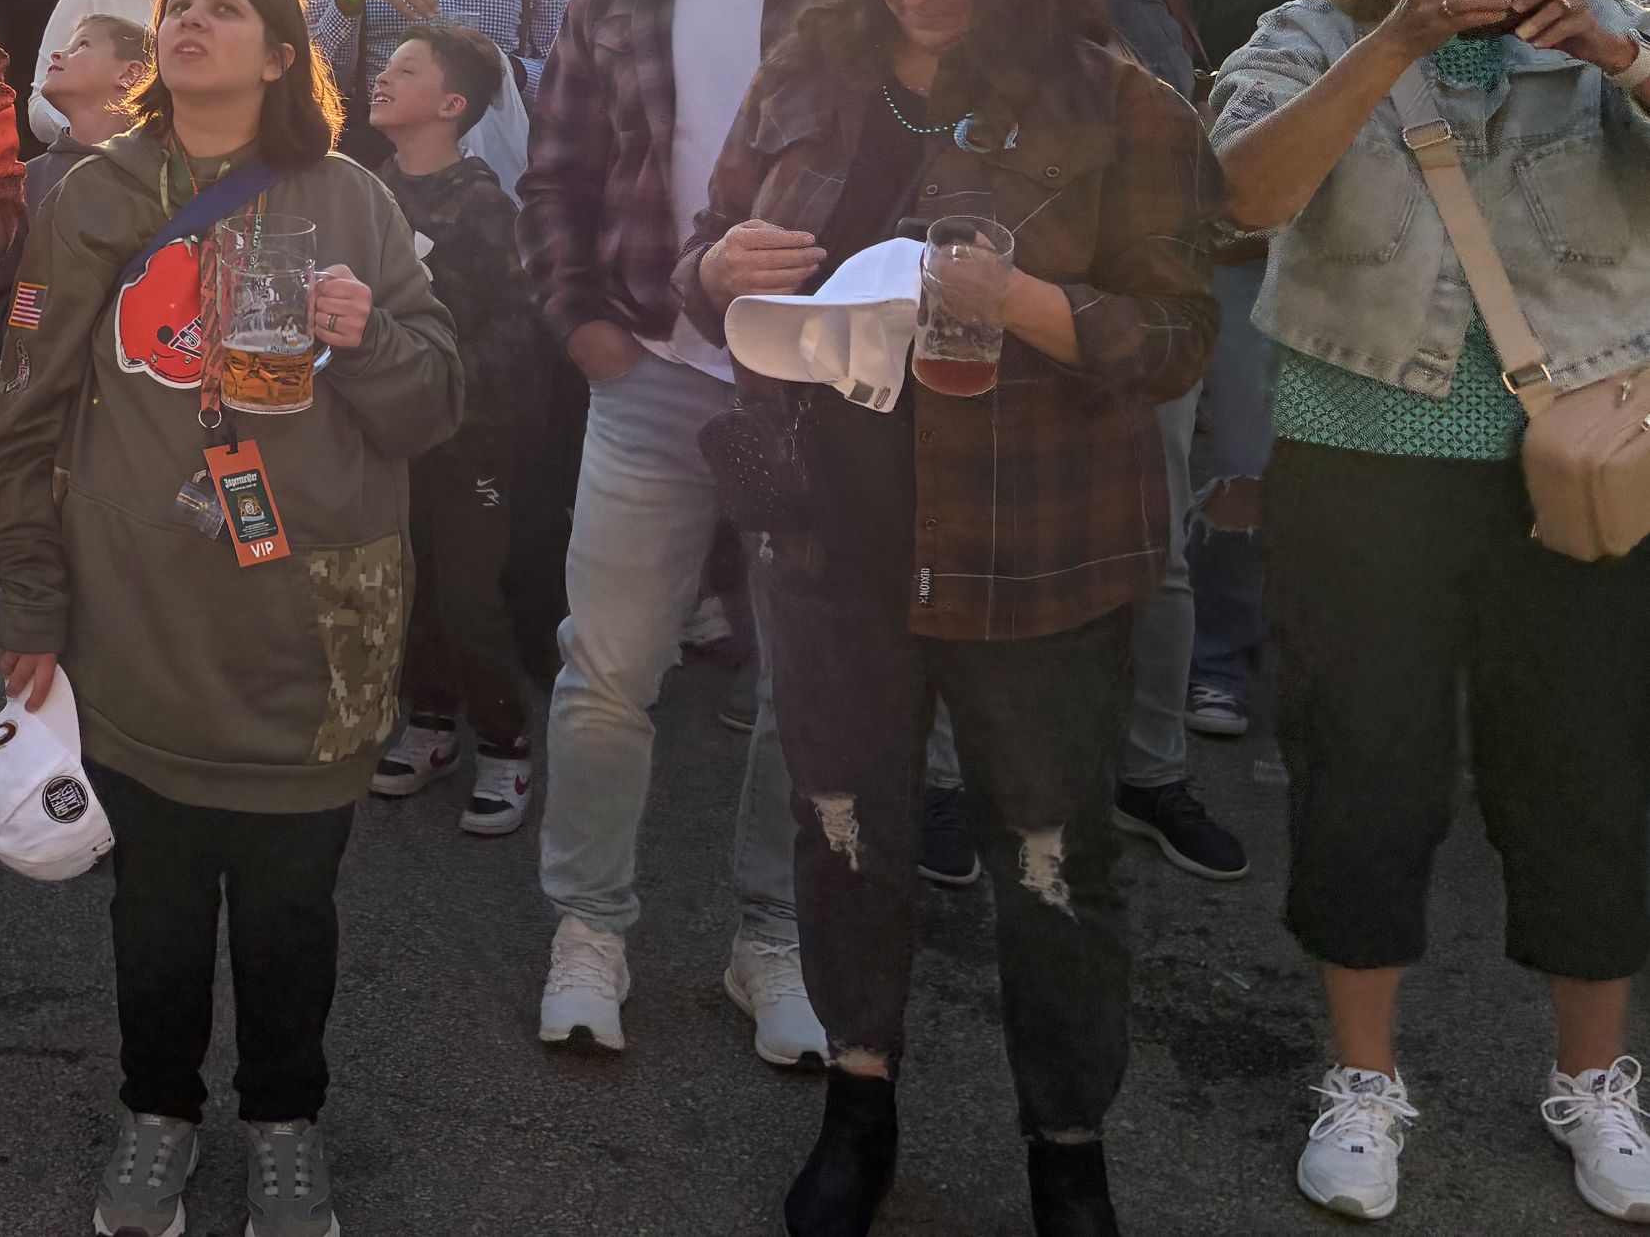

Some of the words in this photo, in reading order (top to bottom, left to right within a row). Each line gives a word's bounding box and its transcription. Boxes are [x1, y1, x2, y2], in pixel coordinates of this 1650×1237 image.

[250, 540, 274, 558] VIP
[47, 788, 69, 817] GREAT
[61, 783, 82, 811] LAKES
